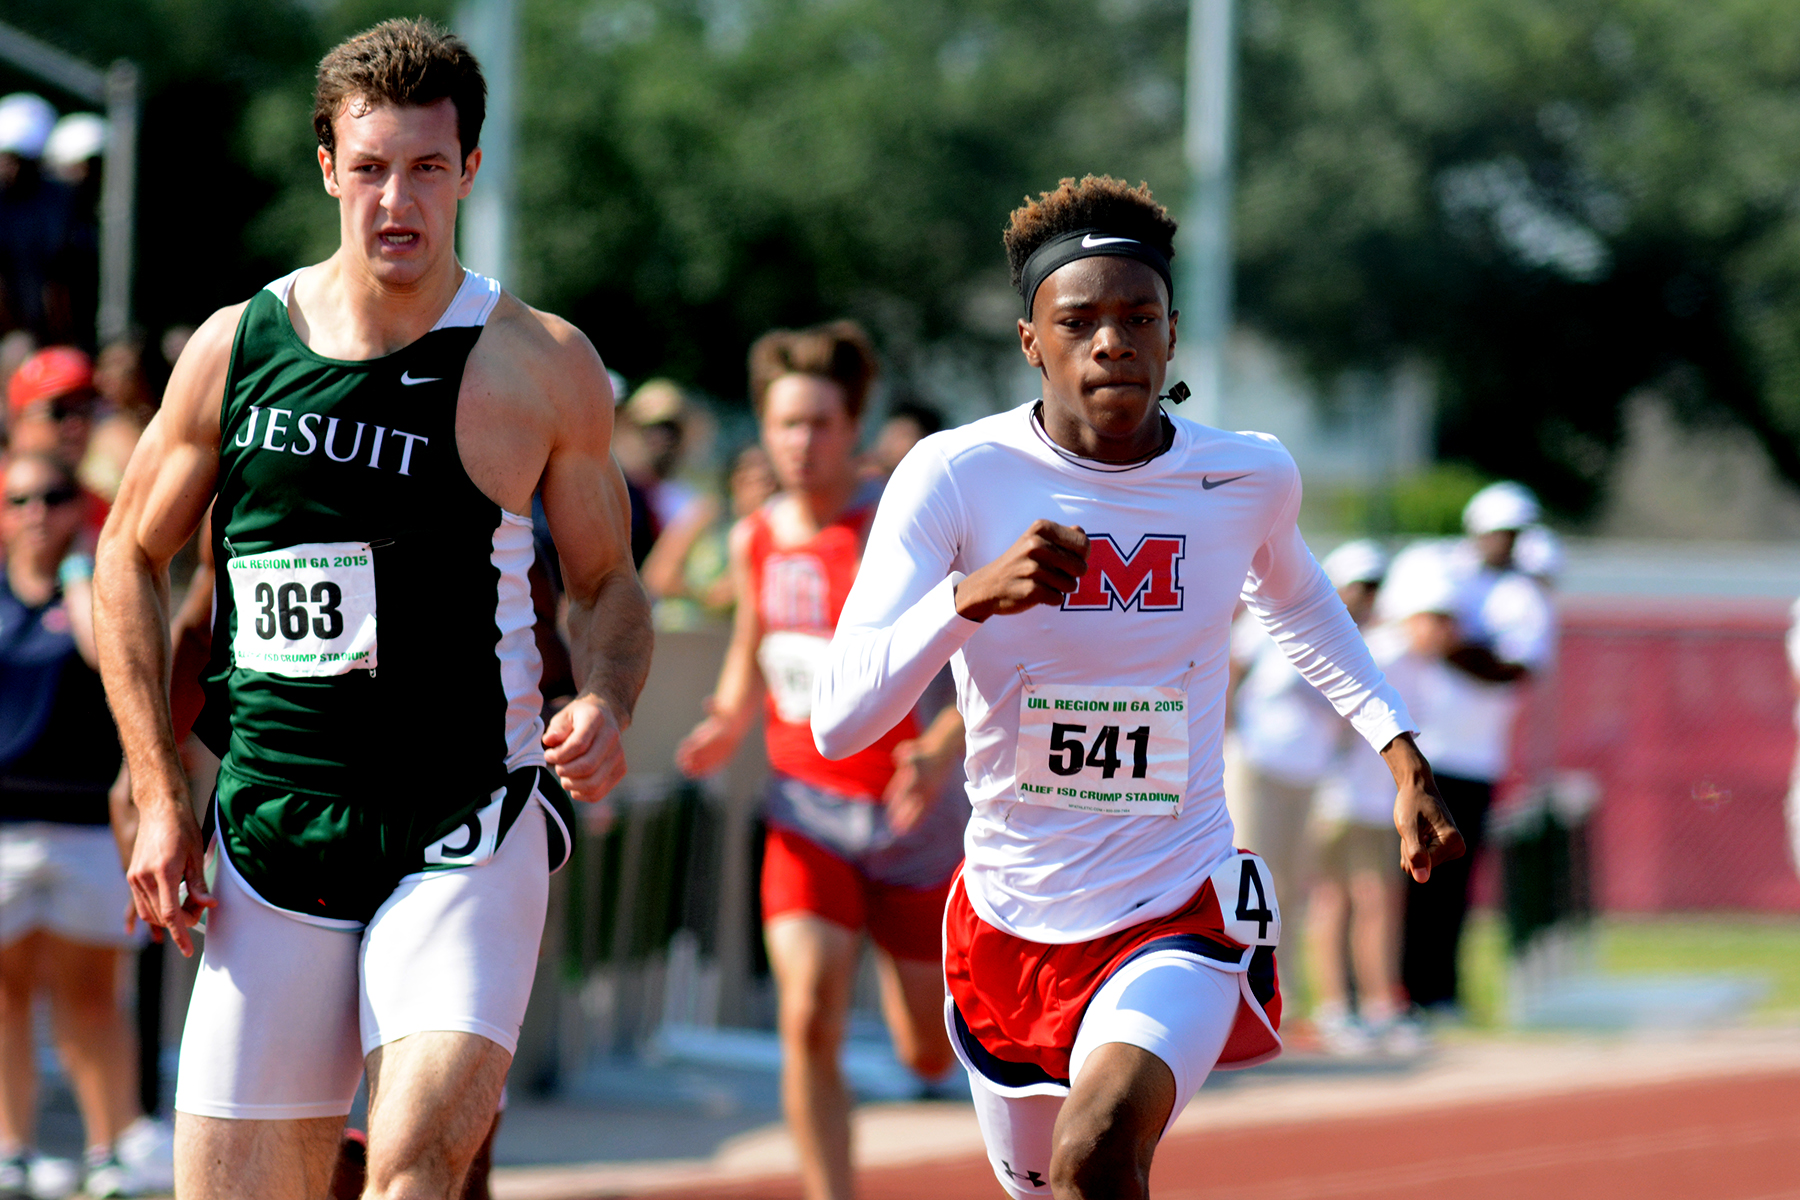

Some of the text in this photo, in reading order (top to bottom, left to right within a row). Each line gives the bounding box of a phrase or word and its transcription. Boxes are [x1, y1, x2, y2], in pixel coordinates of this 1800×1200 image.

[235, 405, 429, 476] JESUIT
[232, 555, 368, 569] UIL REGION III 6A 2015
[1060, 533, 1186, 612] M
[255, 581, 344, 640] 363
[281, 653, 317, 662] CRUMP
[320, 651, 370, 662] STADIUM
[1027, 697, 1184, 712] UIL REGION III 6A 2015
[1048, 722, 1150, 779] 541
[1020, 782, 1180, 803] ALIEF ISD CRUMP STADIUM
[1235, 859, 1274, 939] 4
